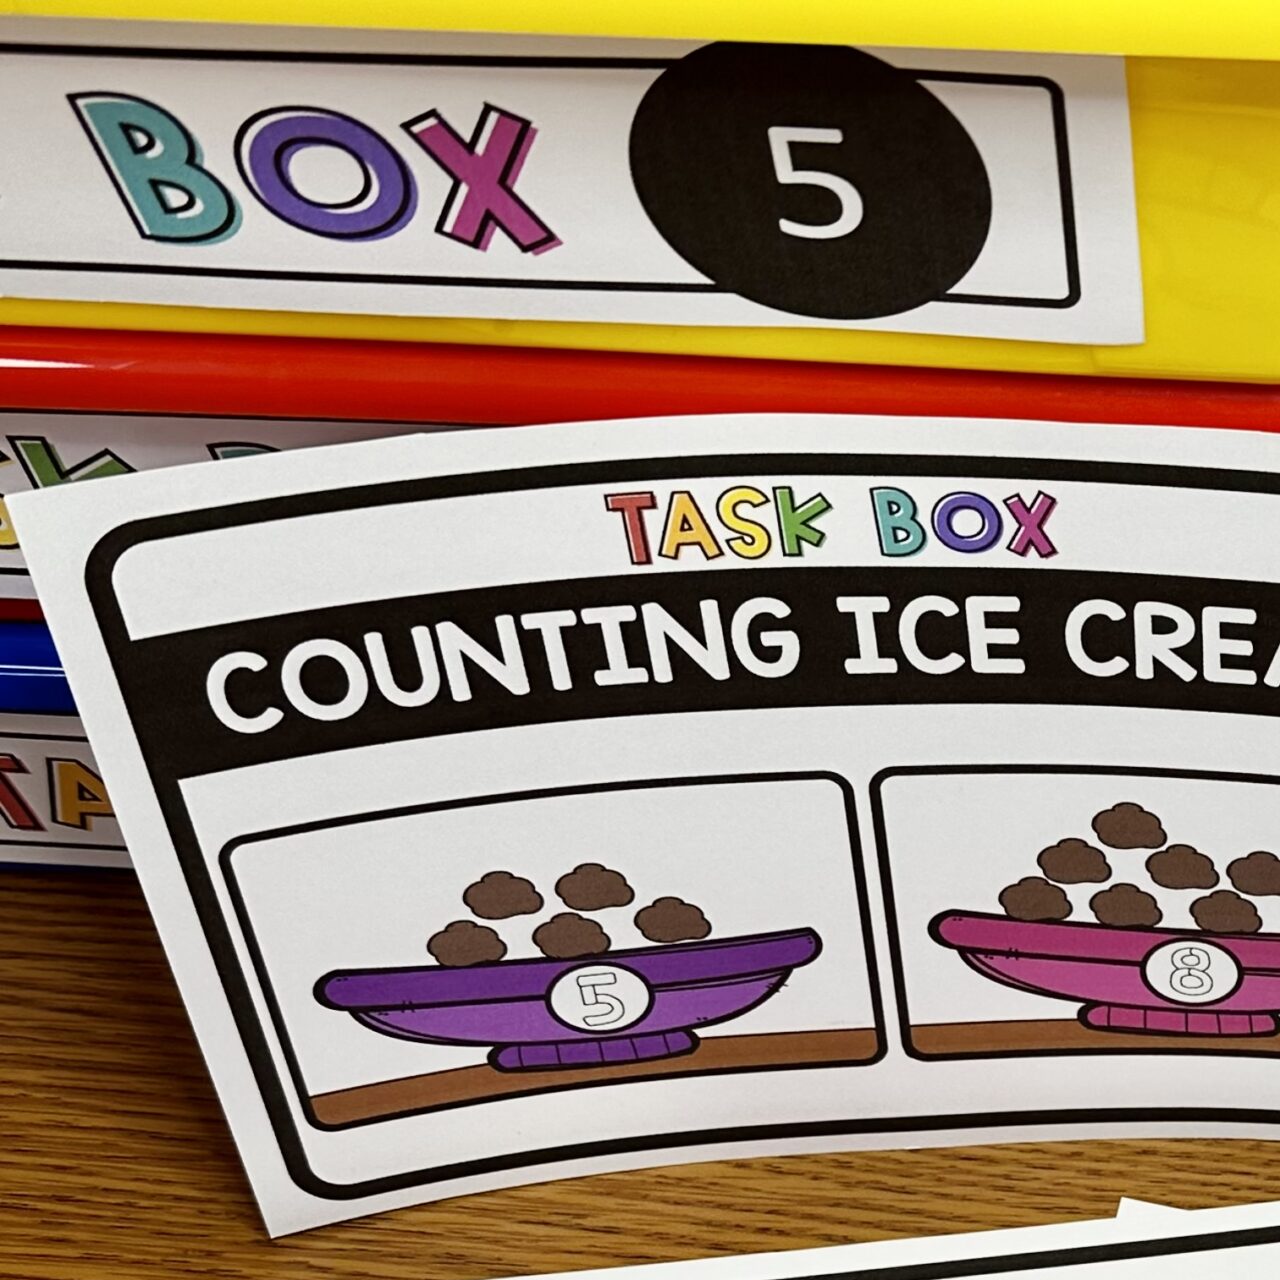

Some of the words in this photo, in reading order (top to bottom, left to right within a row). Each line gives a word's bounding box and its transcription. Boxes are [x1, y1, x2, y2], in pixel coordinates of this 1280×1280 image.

[67, 91, 562, 256] BOX
[767, 126, 864, 239] 5
[605, 486, 833, 566] TASK
[870, 486, 1058, 560] BOX
[206, 596, 801, 734] COUNTING
[835, 594, 1027, 675] ICE
[576, 971, 626, 1027] 5
[1169, 946, 1214, 997] 8
